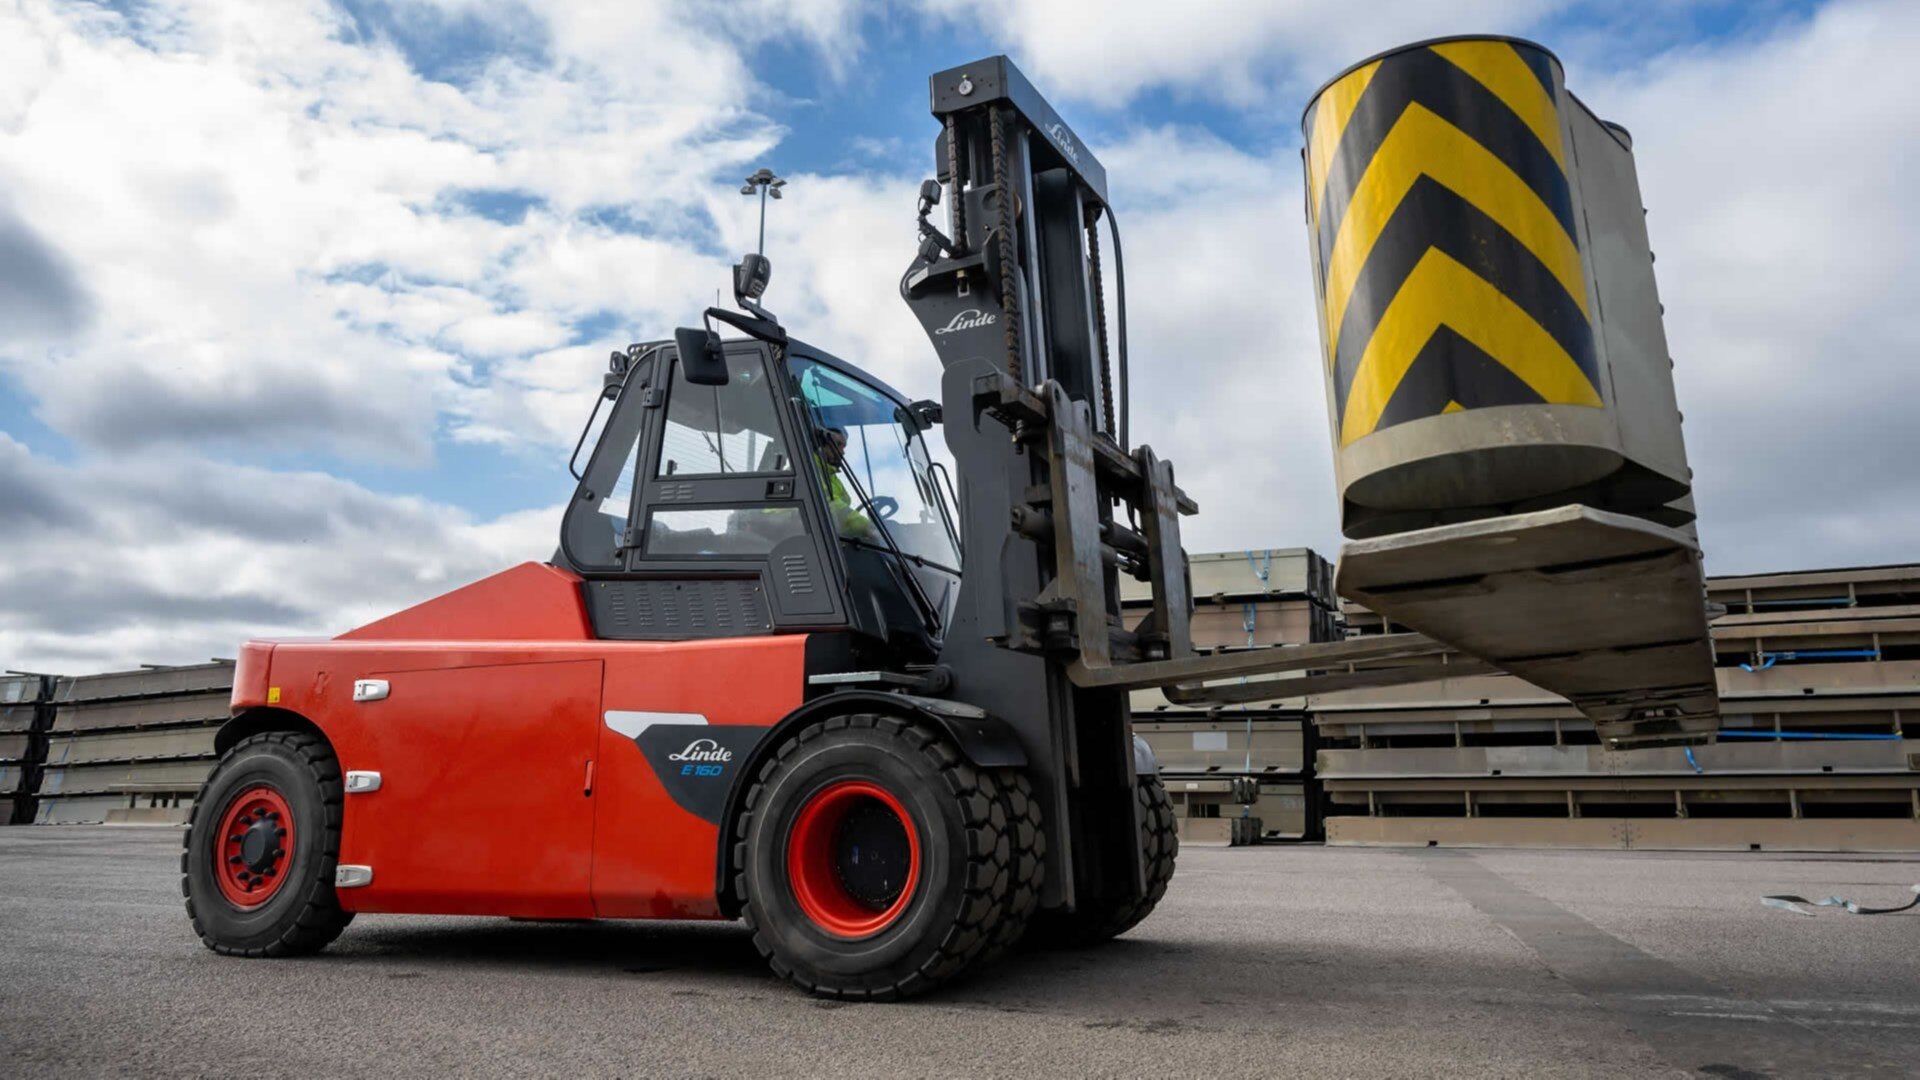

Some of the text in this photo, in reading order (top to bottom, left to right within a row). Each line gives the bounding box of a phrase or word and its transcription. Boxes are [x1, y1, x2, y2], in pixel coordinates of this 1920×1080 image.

[1045, 123, 1079, 164] Linde
[935, 309, 996, 335] Linde
[668, 738, 732, 761] Linde
